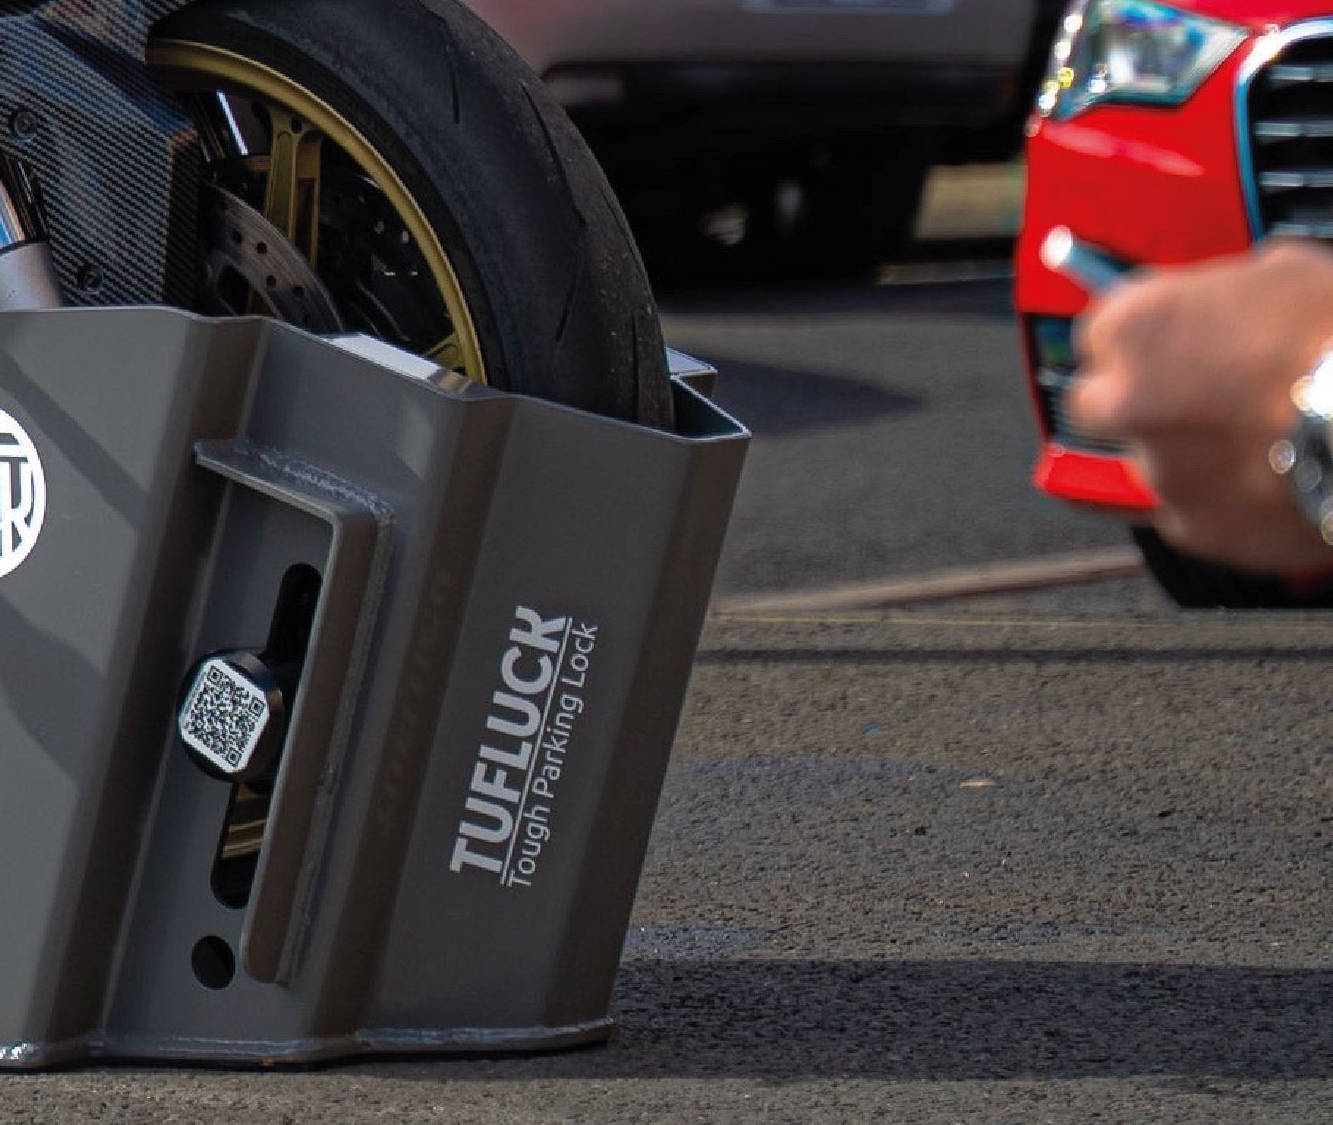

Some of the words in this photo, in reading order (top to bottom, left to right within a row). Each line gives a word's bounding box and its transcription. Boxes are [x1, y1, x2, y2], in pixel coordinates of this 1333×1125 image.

[448, 605, 568, 875] TUFLUCK
[506, 802, 552, 888] Tough
[532, 691, 585, 799] Parking
[561, 622, 600, 688] Lock
